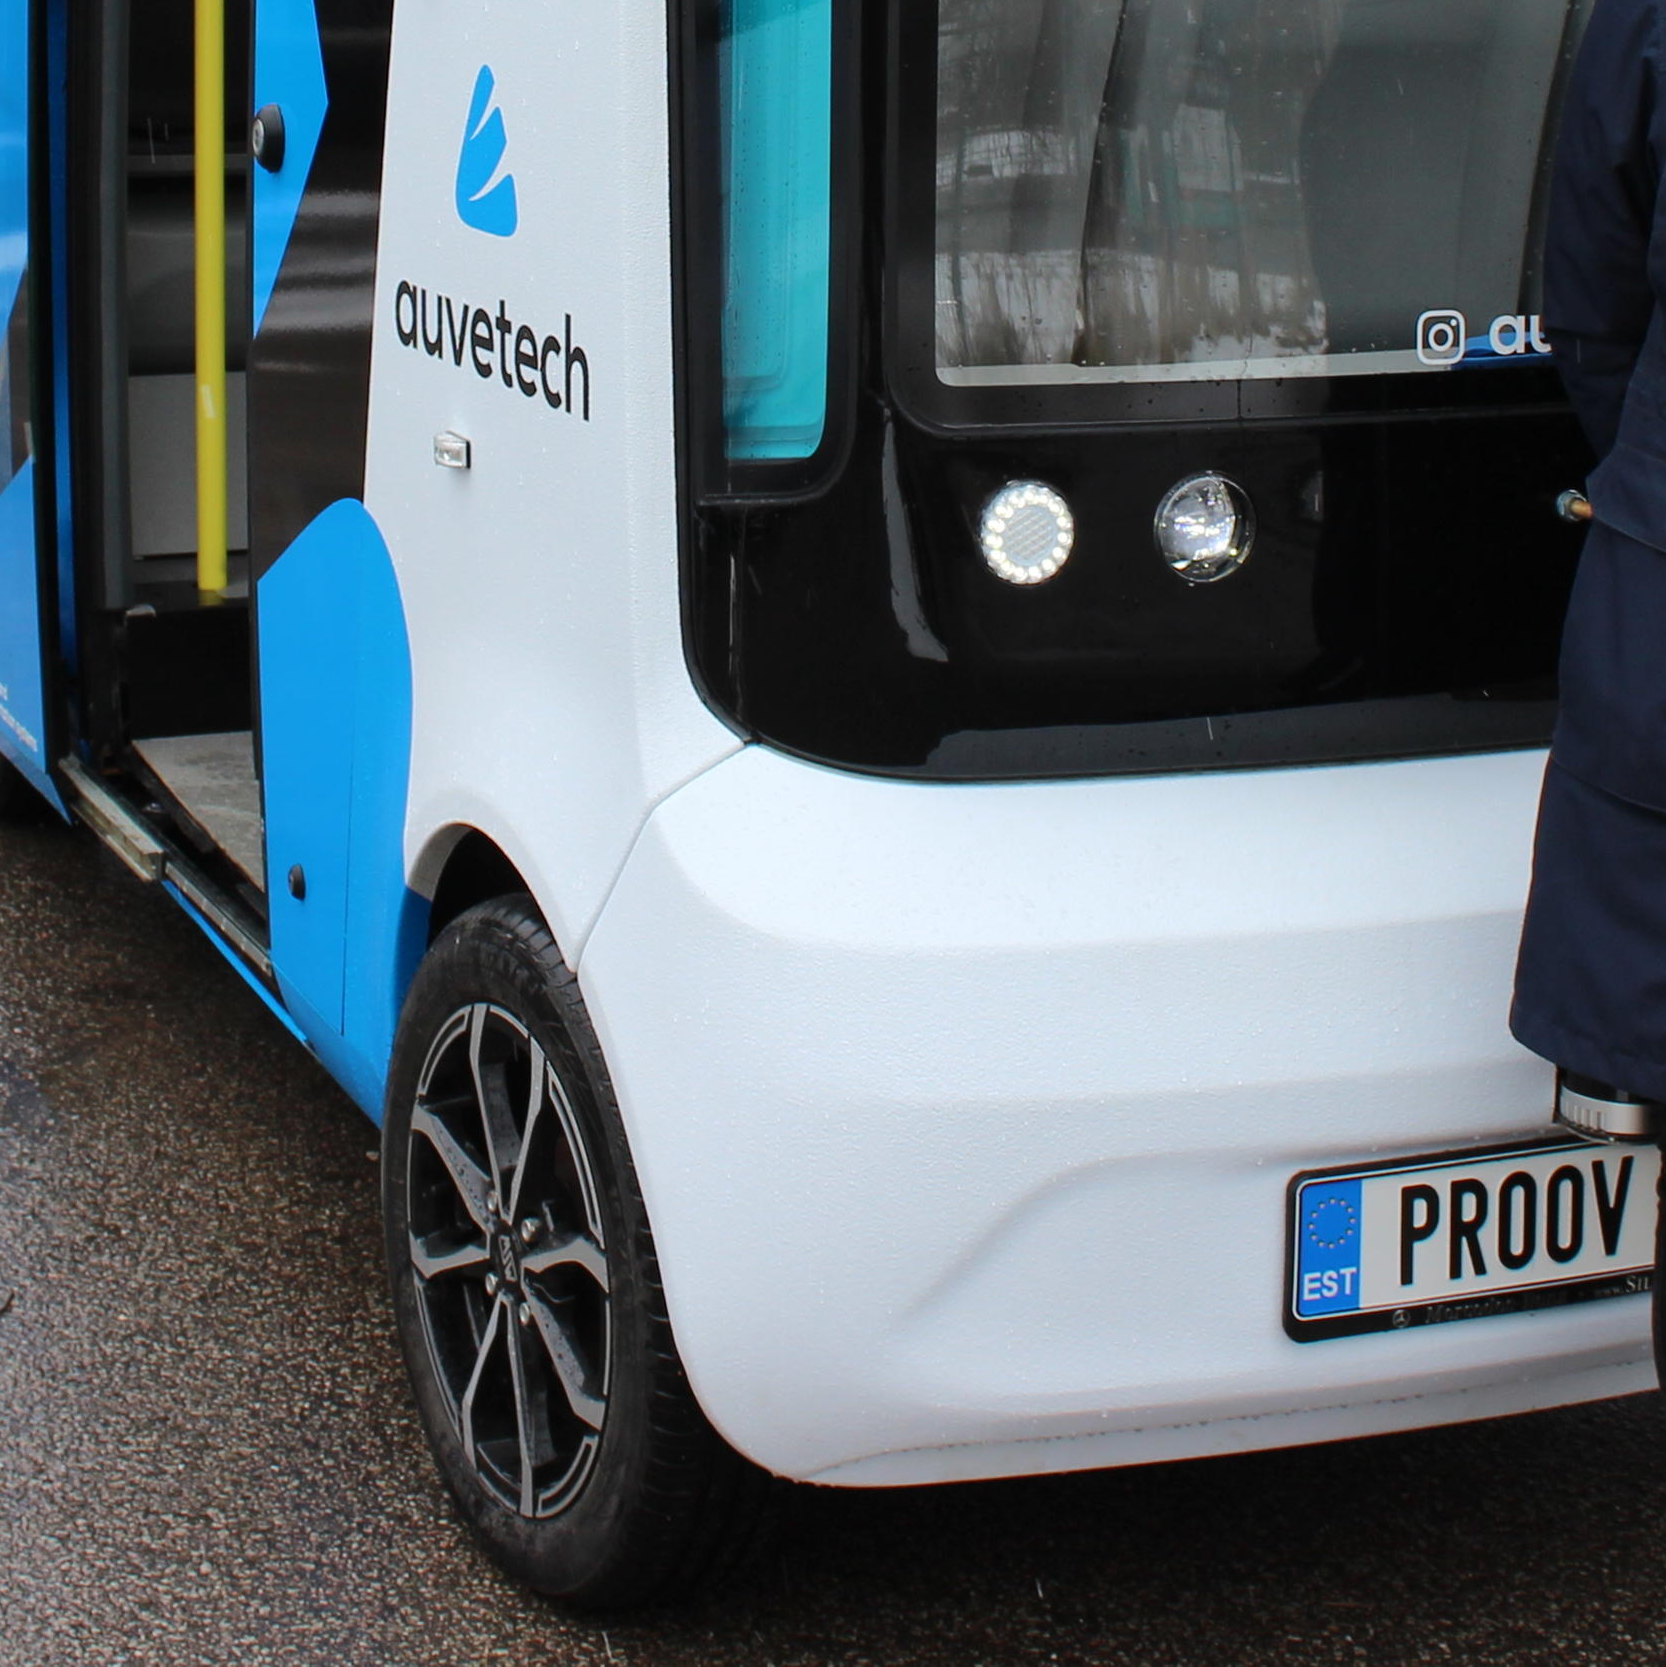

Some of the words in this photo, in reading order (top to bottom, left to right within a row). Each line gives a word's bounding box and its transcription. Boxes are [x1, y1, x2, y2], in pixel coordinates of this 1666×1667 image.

[395, 279, 590, 423] auvetech
[1301, 1267, 1358, 1301] EST
[1400, 1155, 1635, 1287] PROOV
